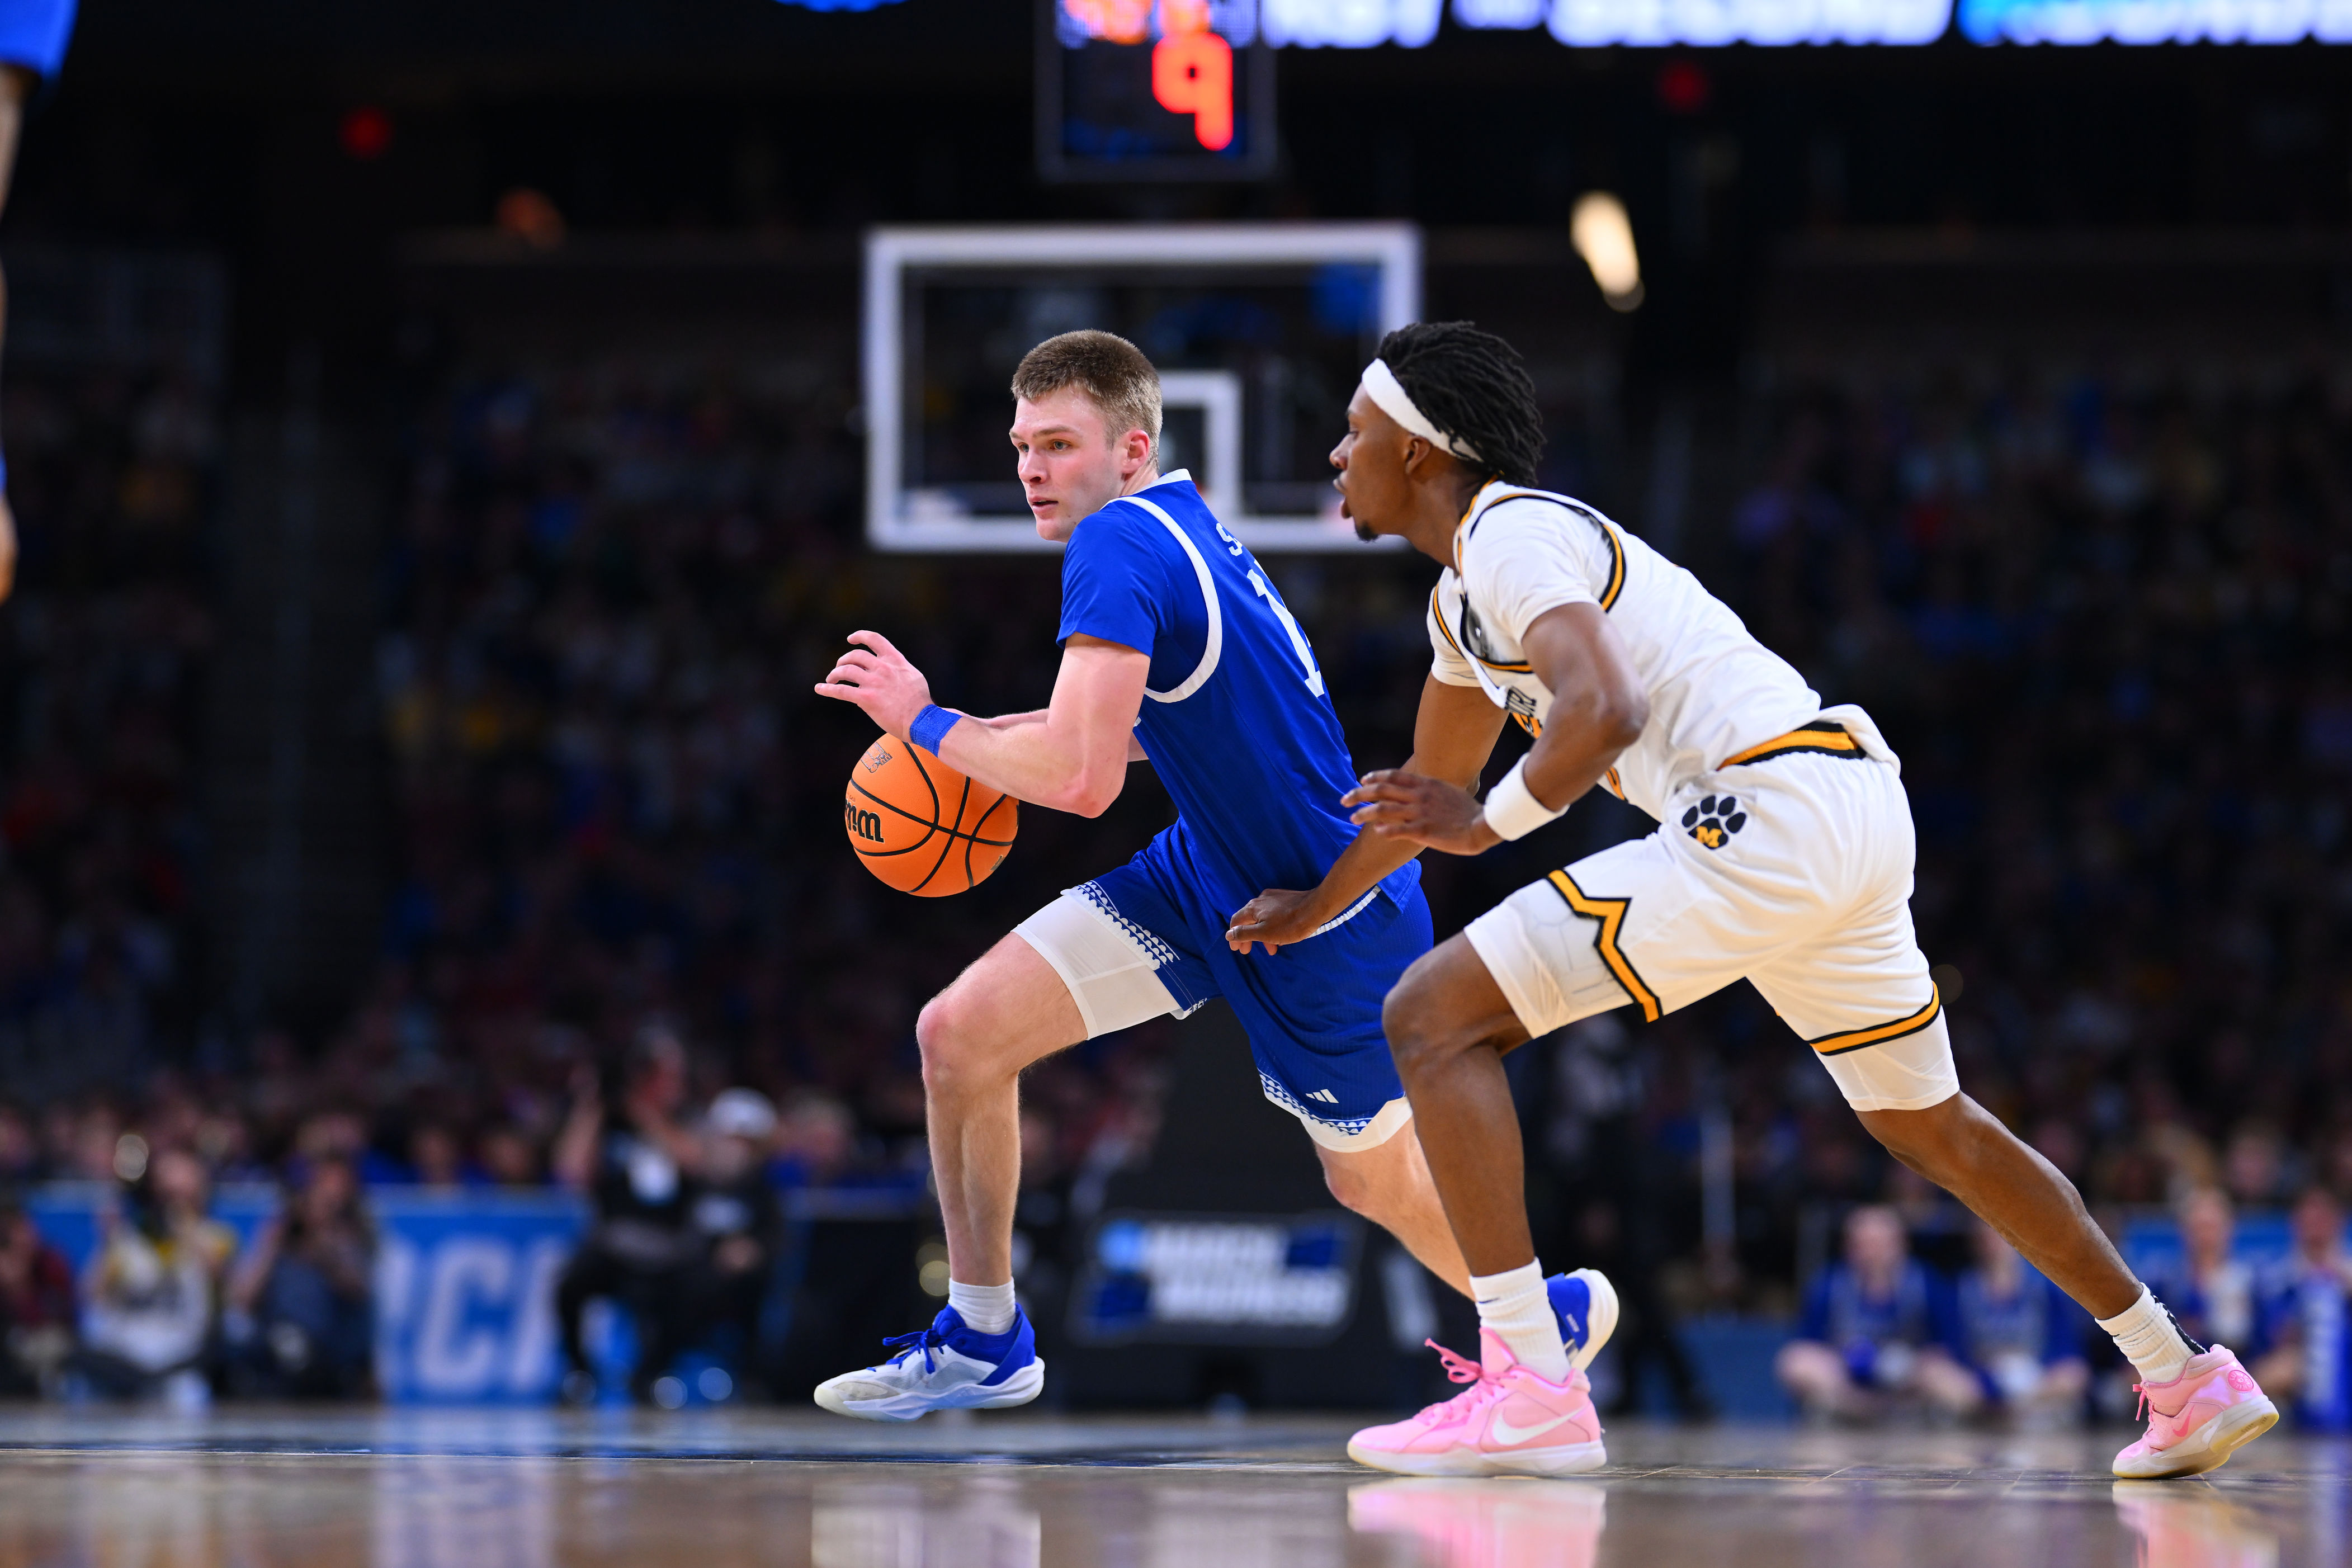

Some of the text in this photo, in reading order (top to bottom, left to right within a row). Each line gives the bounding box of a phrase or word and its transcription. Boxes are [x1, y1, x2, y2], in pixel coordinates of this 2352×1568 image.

[1152, 32, 1234, 151] 9
[1246, 559, 1325, 698] 1
[845, 799, 885, 844] Wil
[1696, 825, 1722, 848] M
